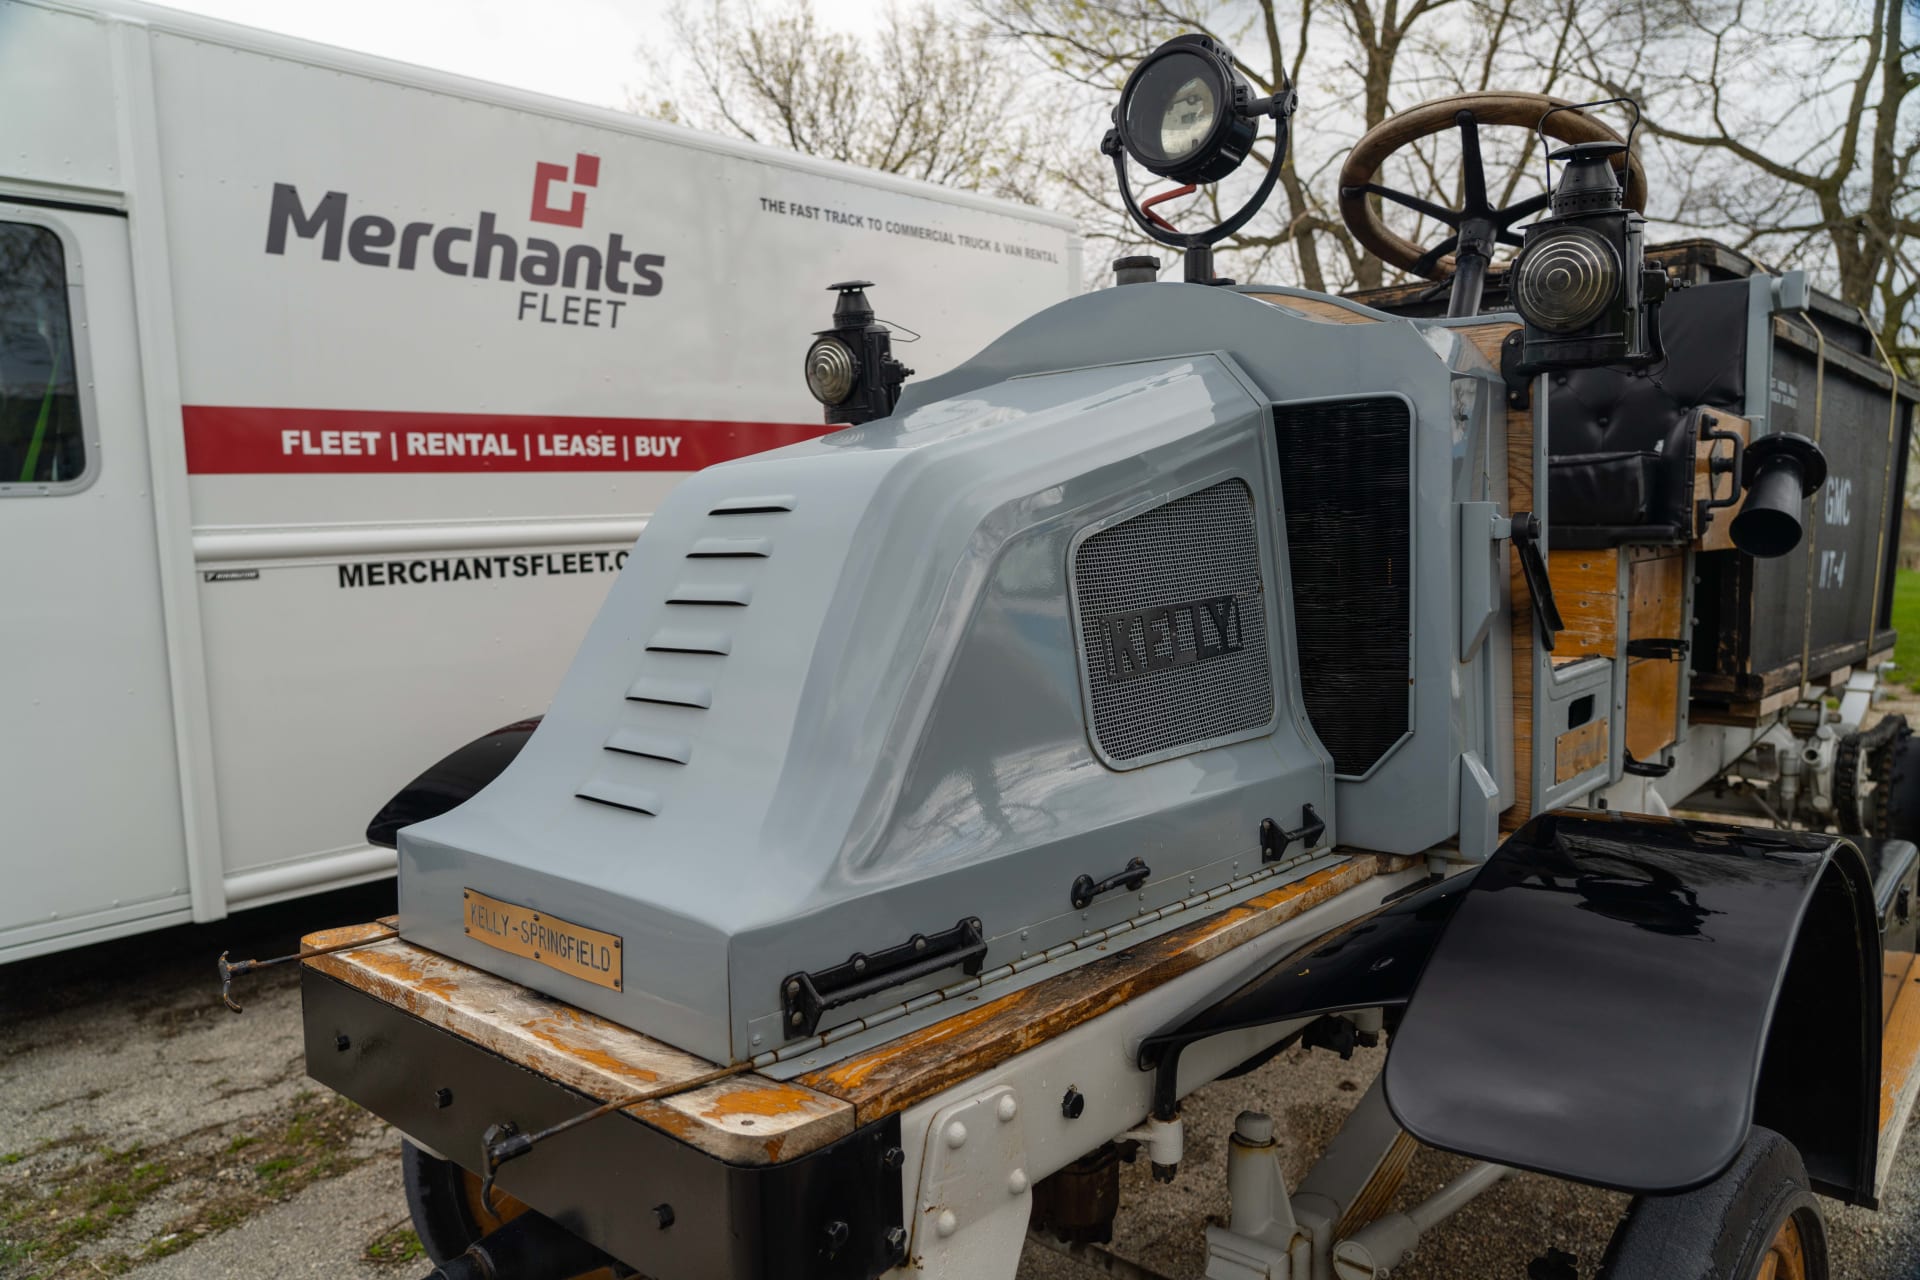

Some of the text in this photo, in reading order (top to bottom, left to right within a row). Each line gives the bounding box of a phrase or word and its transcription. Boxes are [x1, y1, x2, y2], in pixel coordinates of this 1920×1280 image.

[265, 182, 666, 297] Merchants
[760, 197, 1059, 264] THE FAST TRACK TO COMMERCIAL TRUCK & VAN RENTAL
[518, 291, 627, 328] FLEET
[281, 430, 682, 458] FLEET RENTAL LEASE BUY
[1825, 476, 1852, 526] GMC
[1106, 595, 1240, 680] KELLY
[471, 903, 611, 972] KELLY-SPRINGFIELD
